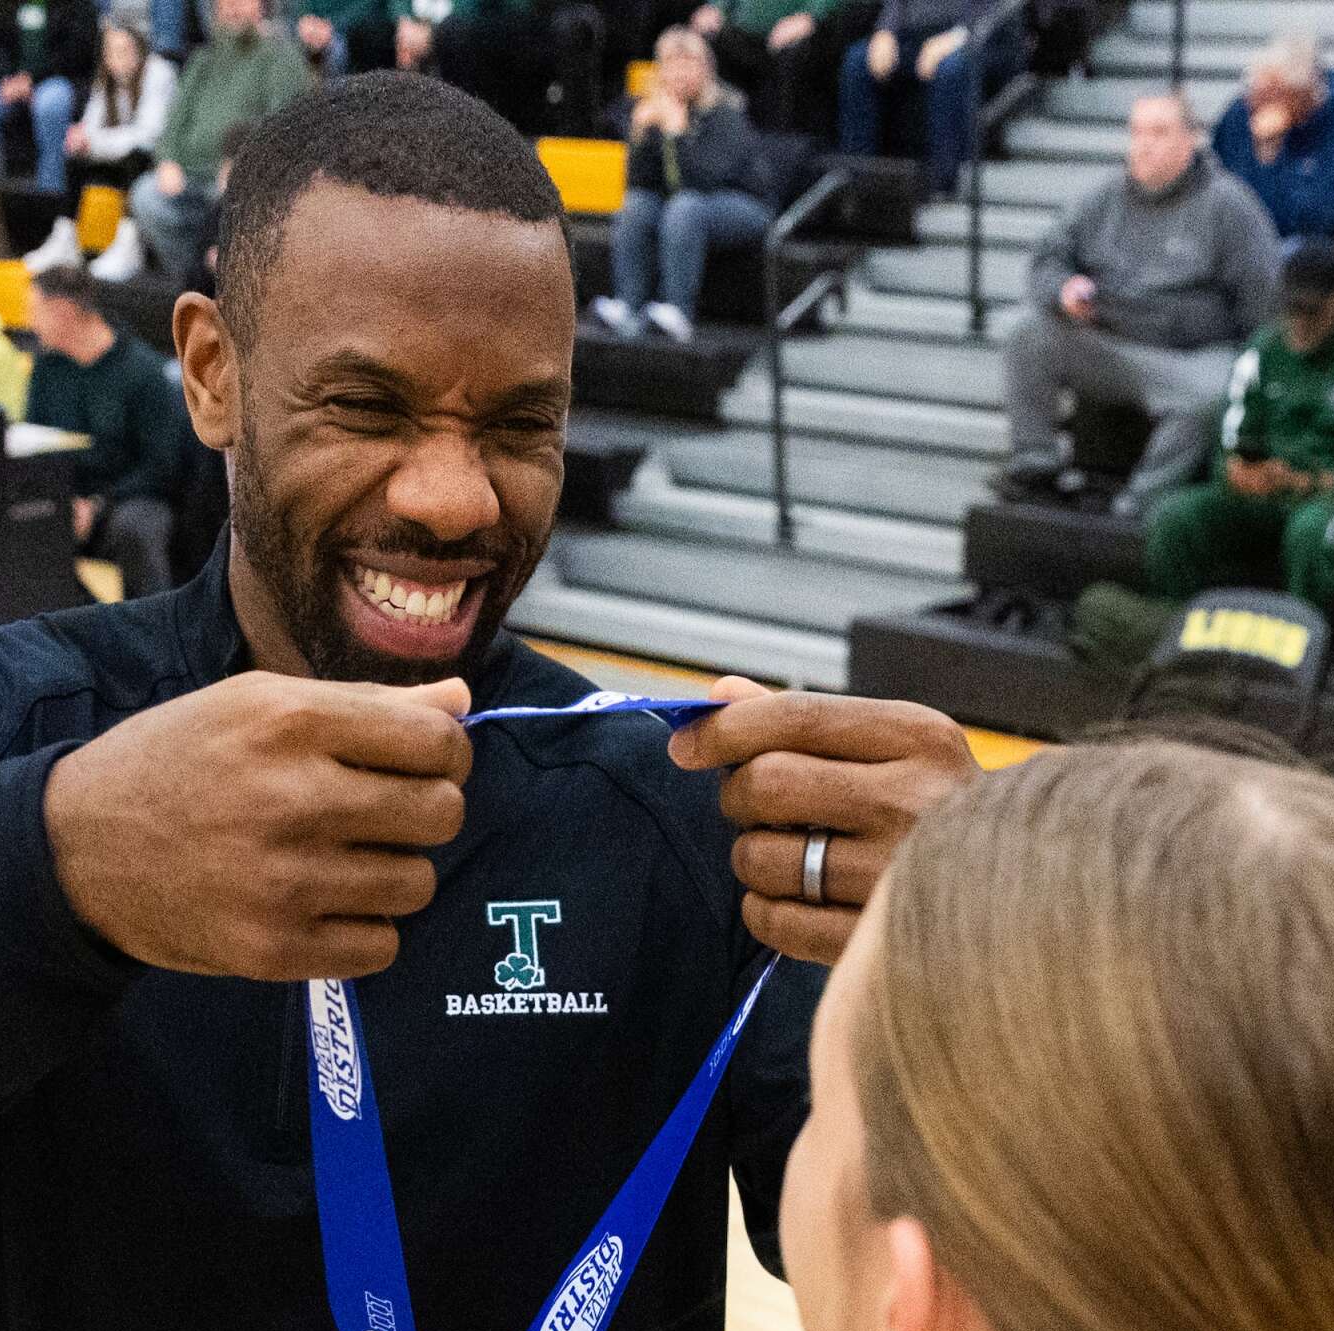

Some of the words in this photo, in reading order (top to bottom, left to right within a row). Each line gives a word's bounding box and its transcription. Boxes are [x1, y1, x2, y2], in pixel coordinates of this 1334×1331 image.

[487, 900, 562, 988] T
[445, 991, 609, 1015] BASKETBALL
[325, 979, 362, 1120] DISTRIC
[579, 1256, 623, 1330] PIAA
